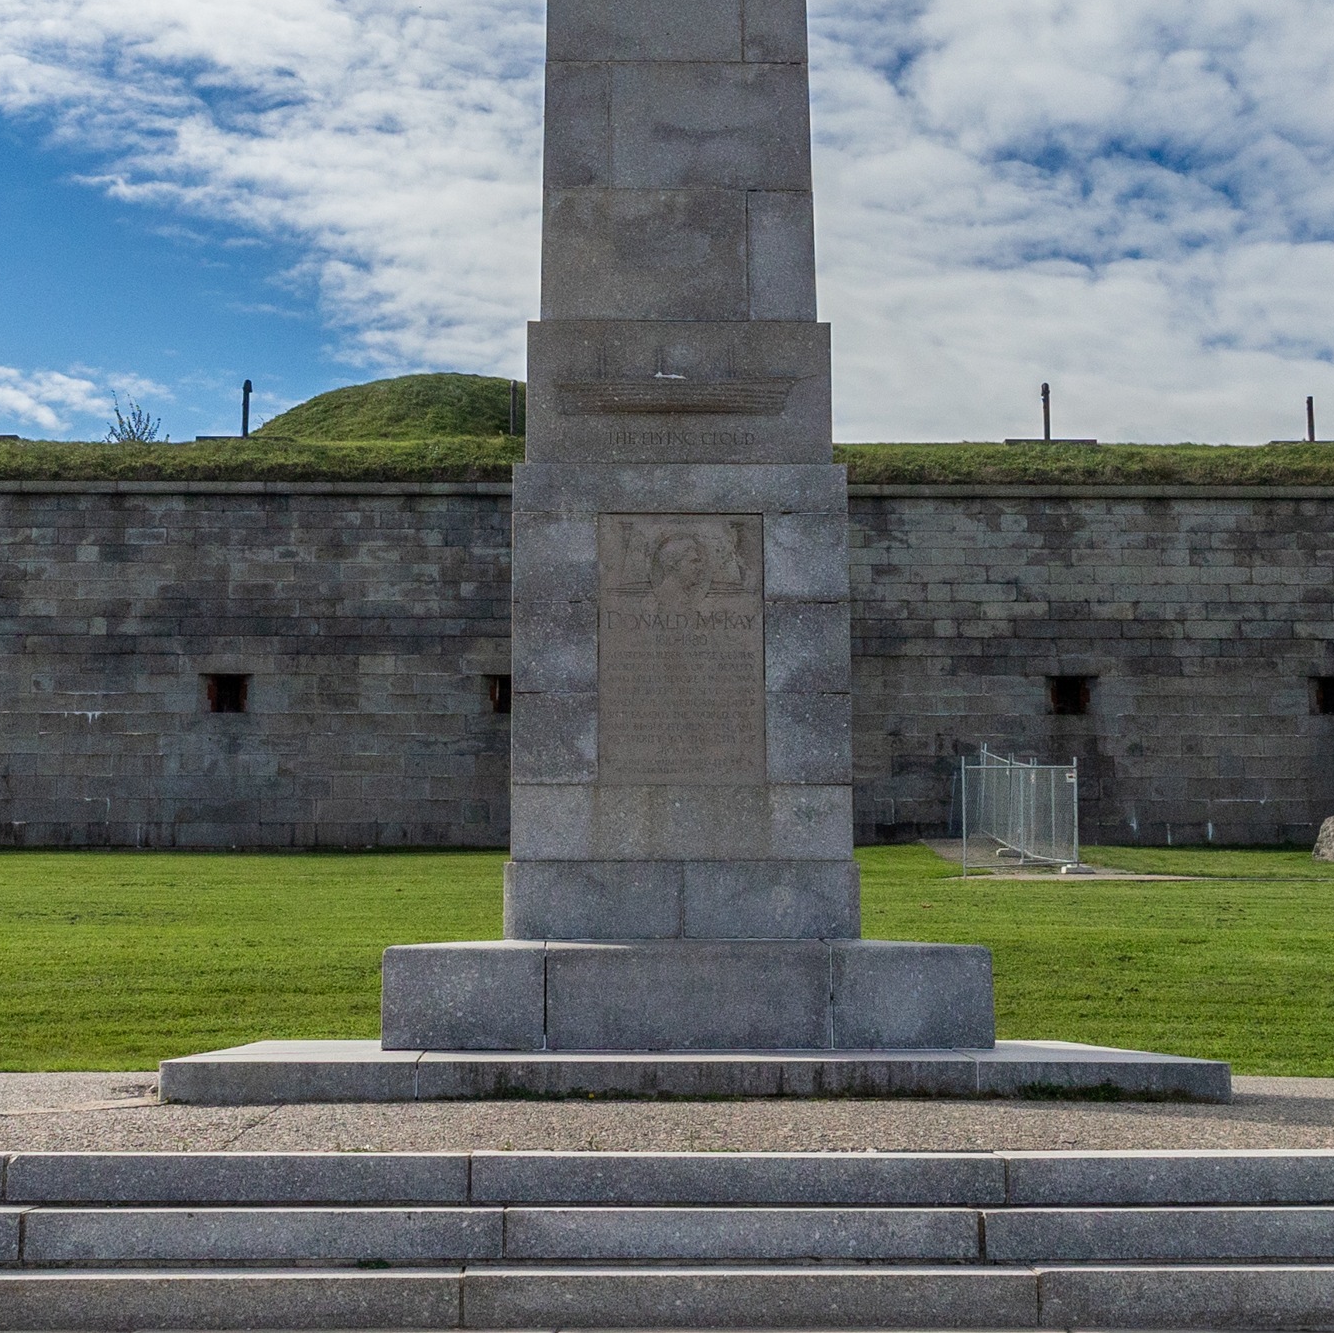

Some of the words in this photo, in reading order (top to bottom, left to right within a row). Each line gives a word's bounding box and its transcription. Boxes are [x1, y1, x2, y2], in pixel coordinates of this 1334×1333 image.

[607, 431, 636, 446] THE
[641, 431, 696, 446] FLYING
[700, 431, 756, 446] CLOUD
[606, 610, 689, 631] DONALD
